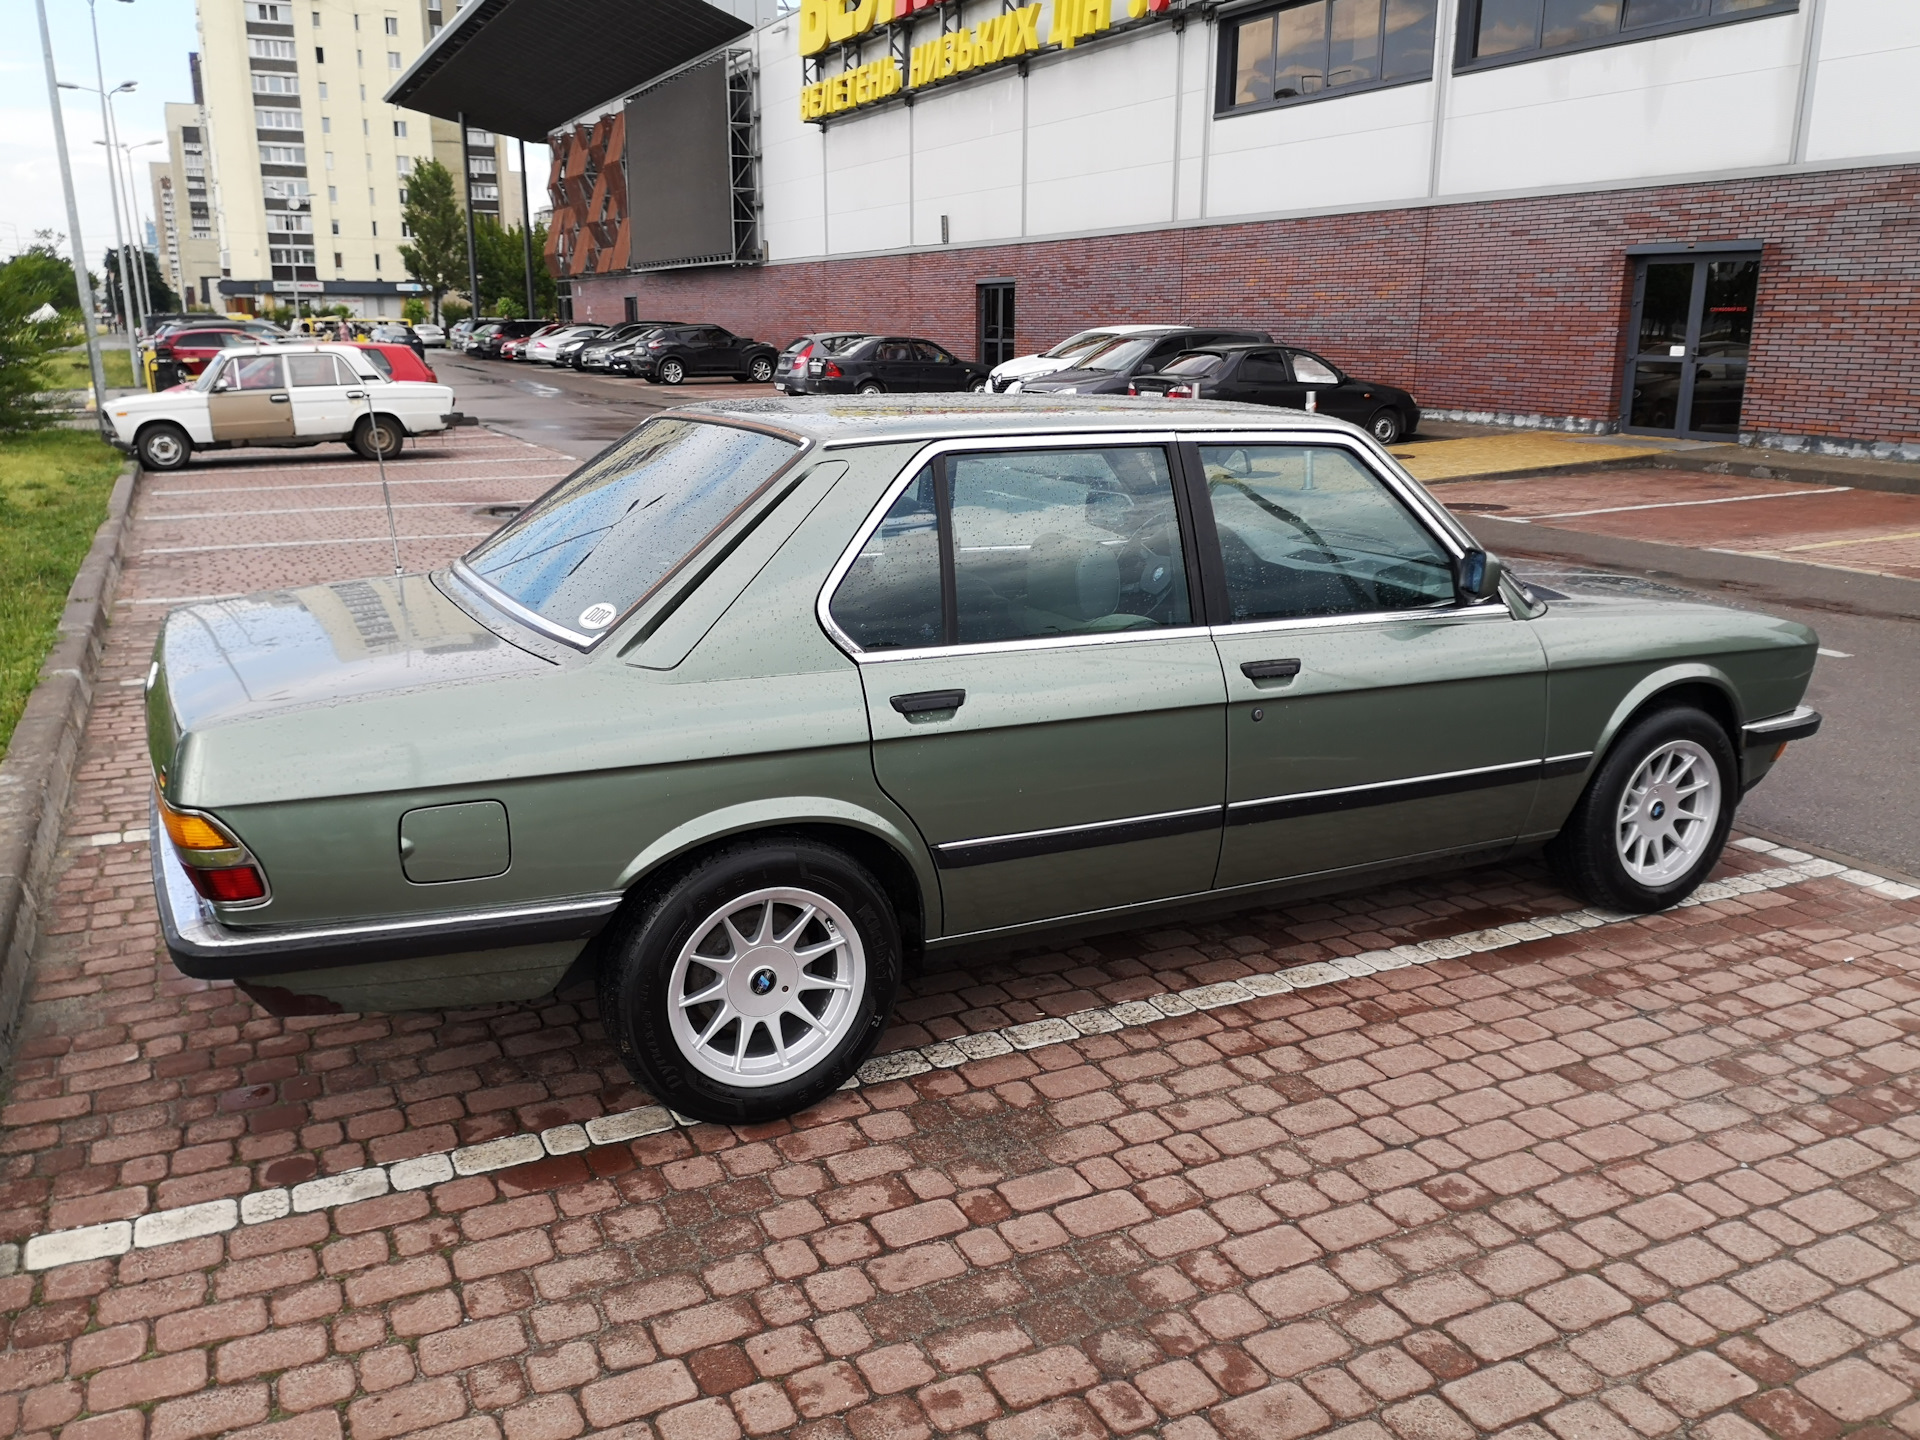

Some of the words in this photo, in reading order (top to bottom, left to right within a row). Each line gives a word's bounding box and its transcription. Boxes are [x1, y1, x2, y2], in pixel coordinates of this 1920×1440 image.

[801, 56, 902, 121] ВЕЛЕТЕНЬ
[908, 2, 1042, 88] НИЗЬКИХ
[585, 607, 612, 624] DDR
